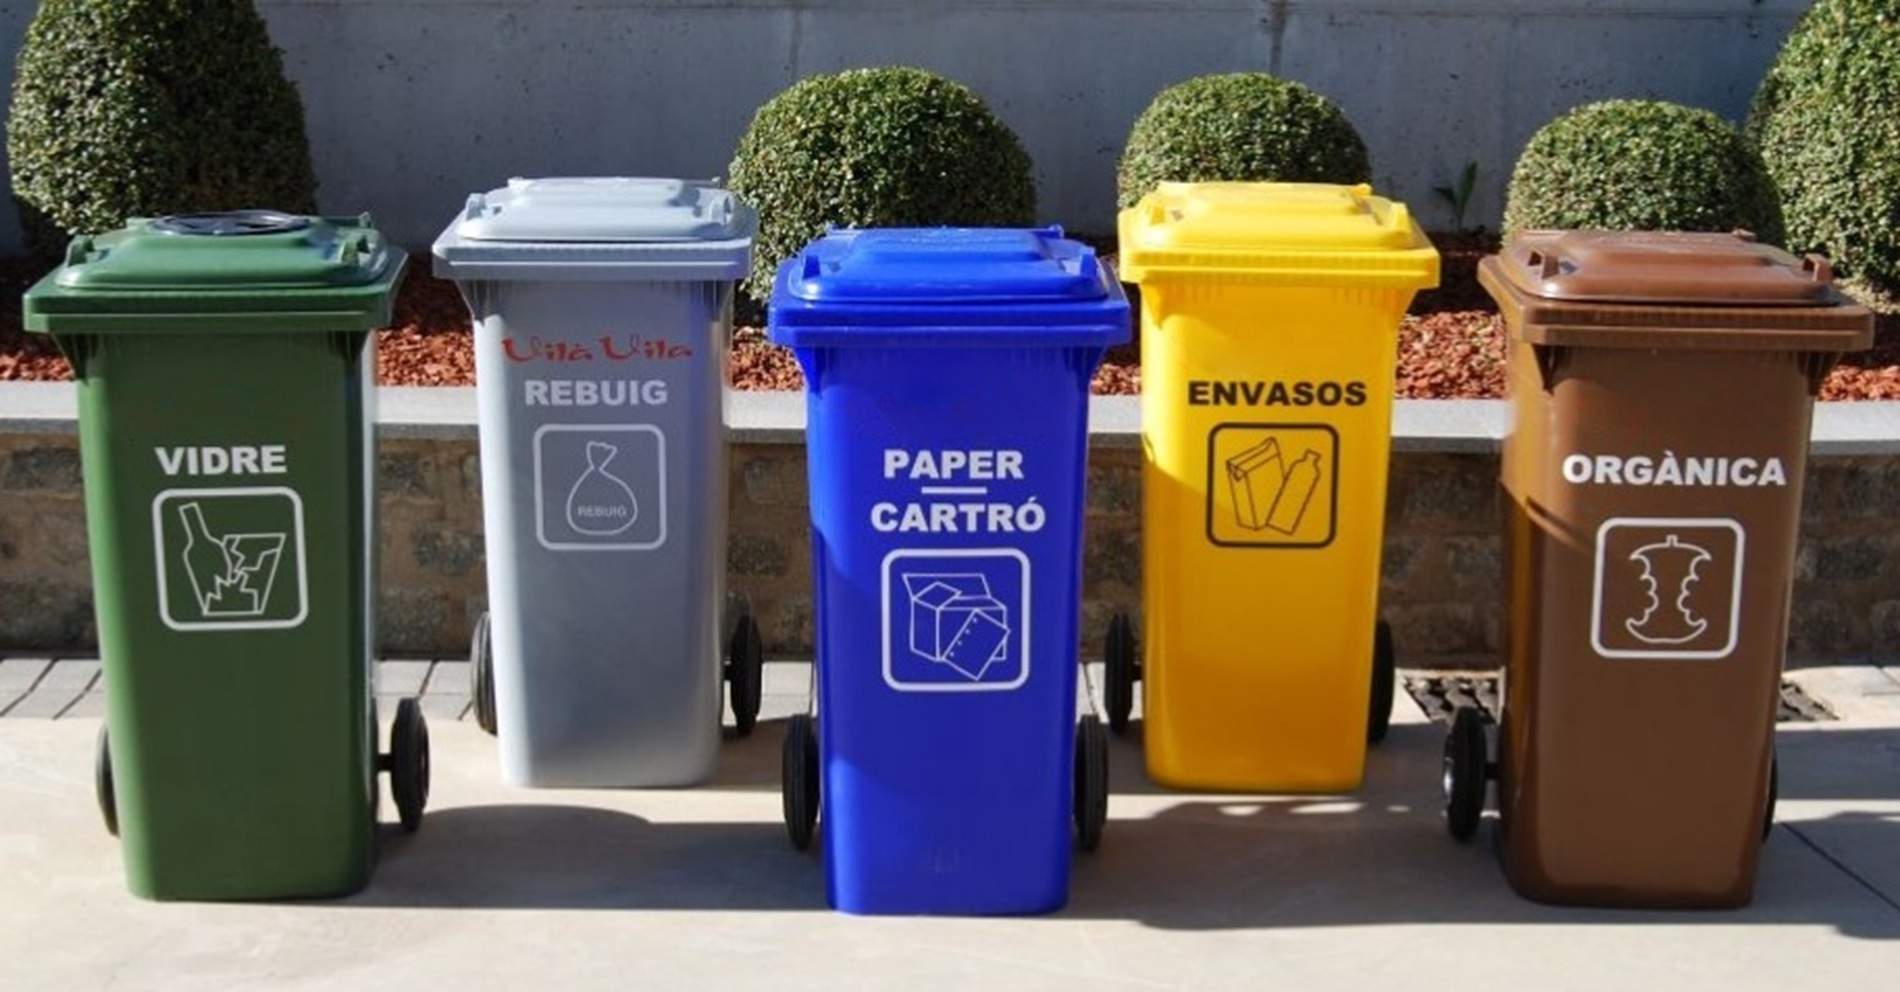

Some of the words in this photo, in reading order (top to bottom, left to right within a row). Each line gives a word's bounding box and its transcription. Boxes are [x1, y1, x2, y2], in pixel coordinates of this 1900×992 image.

[524, 379, 668, 406] REBUIG
[1188, 381, 1367, 406] ENVASOS
[154, 445, 288, 475] VIDRE
[883, 449, 1024, 479] PAPER
[1562, 450, 1787, 486] ORGÀNICA
[577, 505, 627, 517] REBUIG
[870, 496, 1046, 532] CARTRÓ
